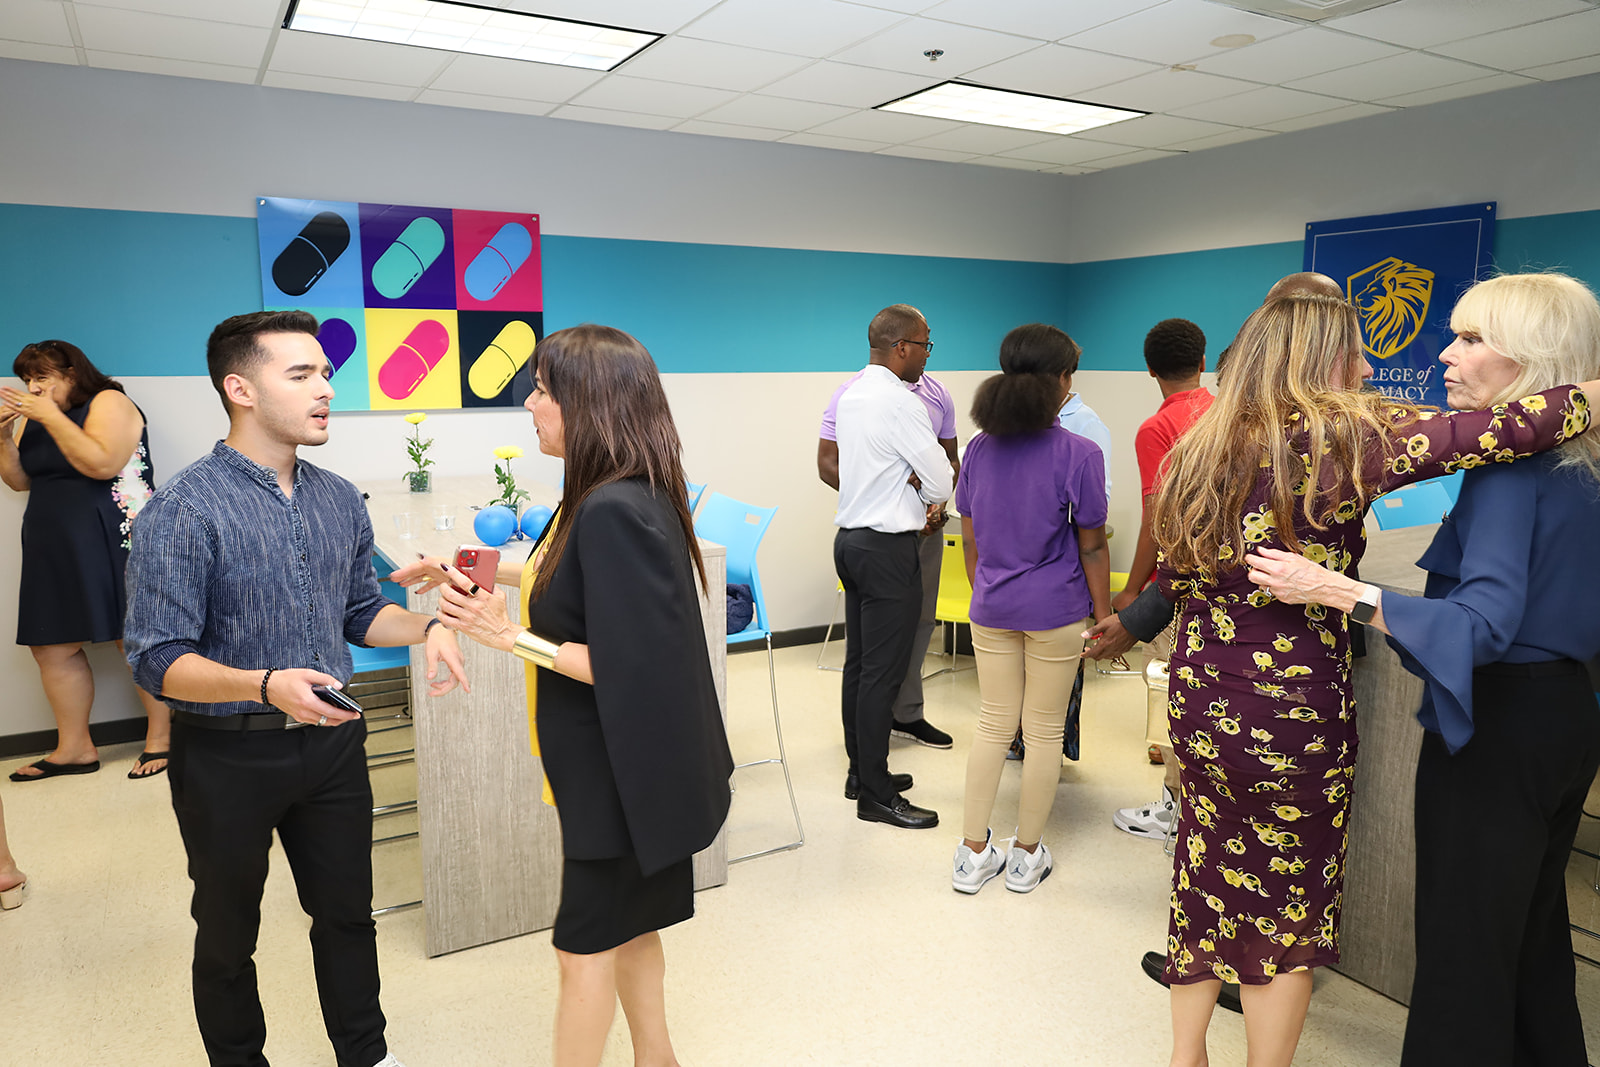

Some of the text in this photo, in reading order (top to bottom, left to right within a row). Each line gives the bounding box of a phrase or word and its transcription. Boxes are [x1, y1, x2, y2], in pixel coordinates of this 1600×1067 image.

[1370, 365, 1436, 385] LEGE of
[1379, 386, 1429, 400] MACY
